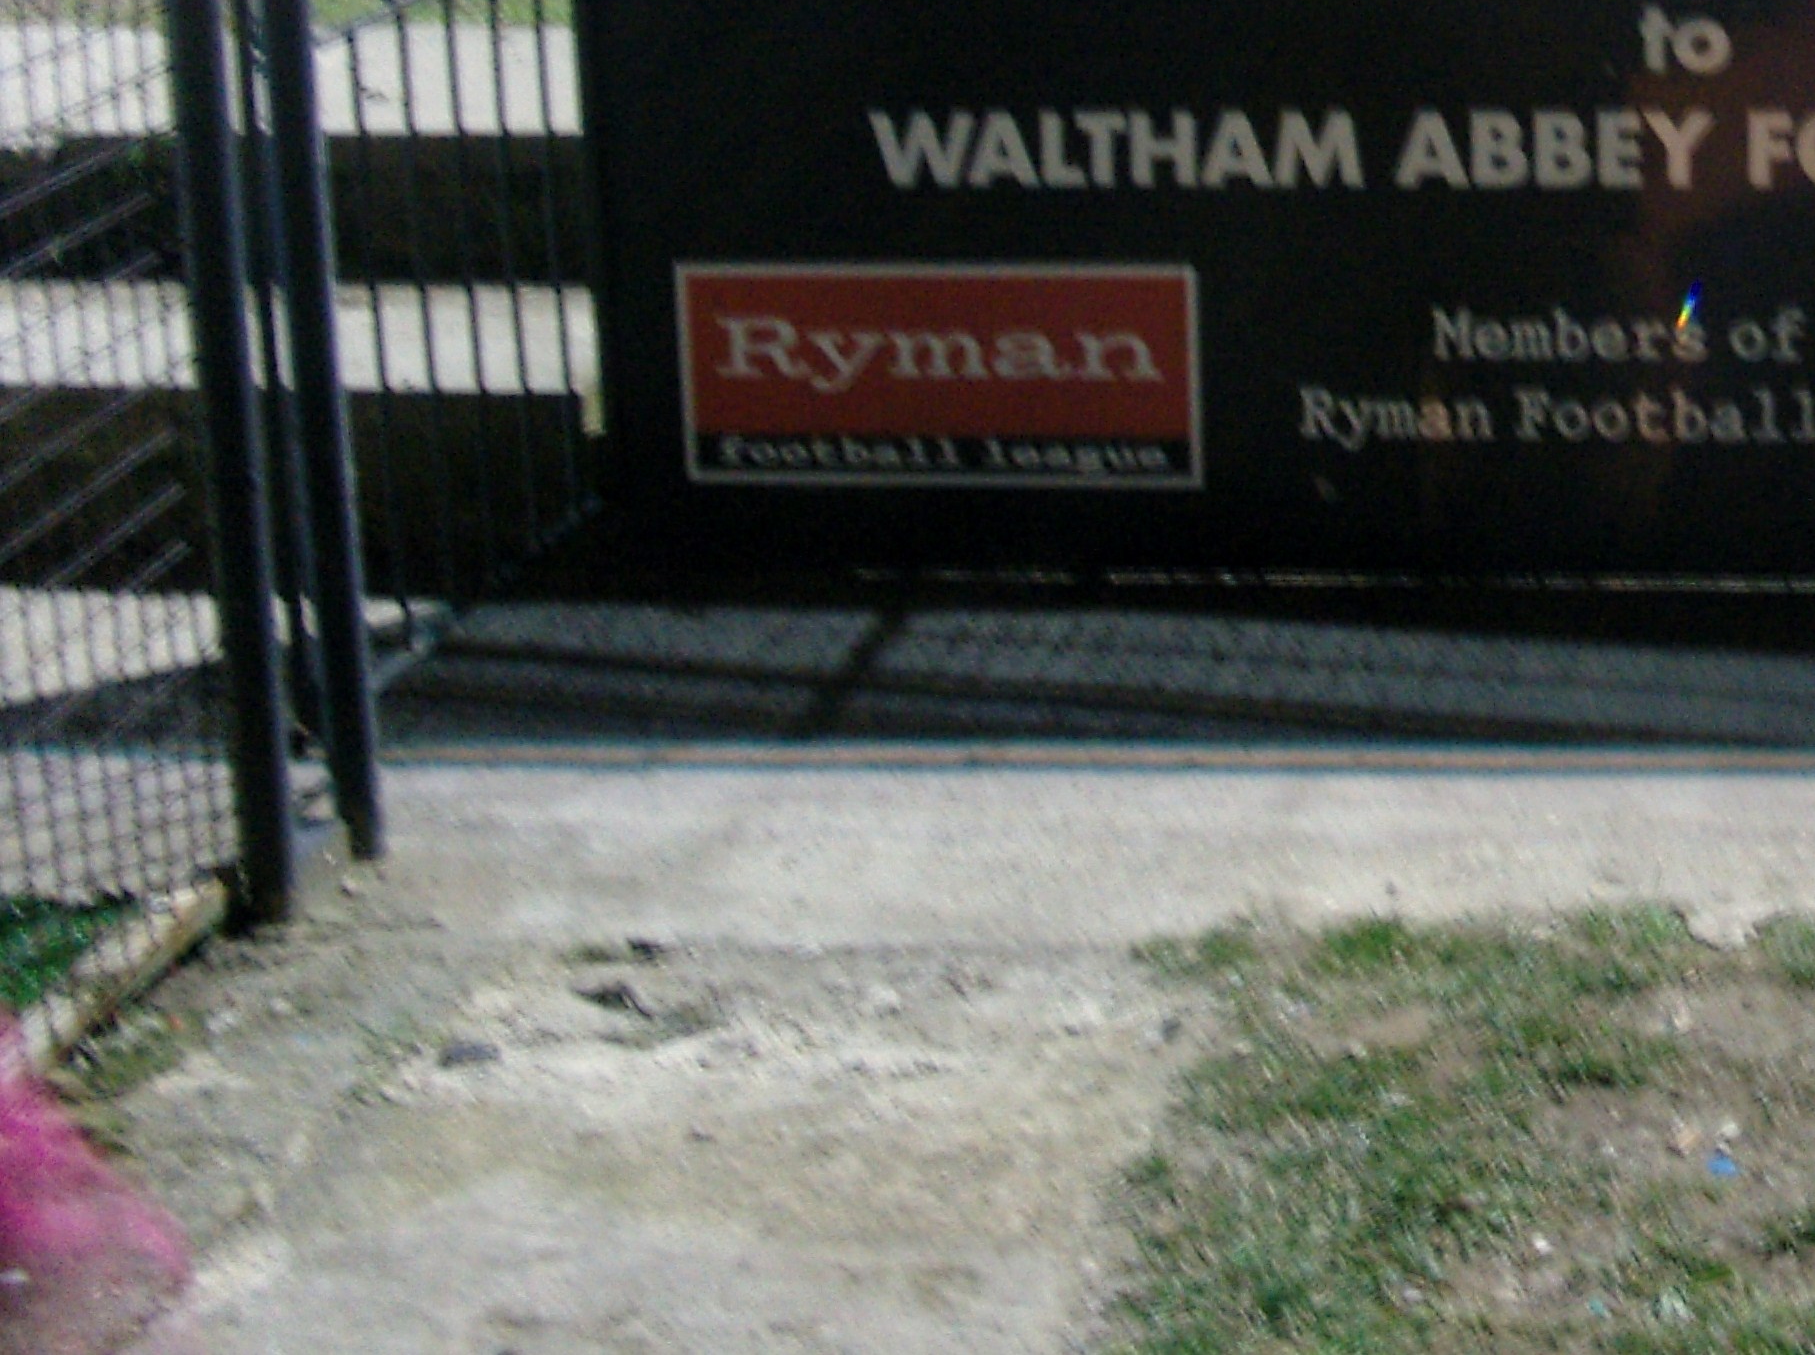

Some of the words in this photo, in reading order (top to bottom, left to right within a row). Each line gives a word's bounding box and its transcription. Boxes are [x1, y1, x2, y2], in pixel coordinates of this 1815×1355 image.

[1641, 5, 1731, 73] to
[868, 108, 1366, 189] WALTHAM
[1397, 108, 1714, 189] ABBEY
[714, 313, 1164, 395] Ryman
[1430, 307, 1706, 365] Members
[1730, 307, 1806, 365] of
[1299, 385, 1492, 453] Ryman
